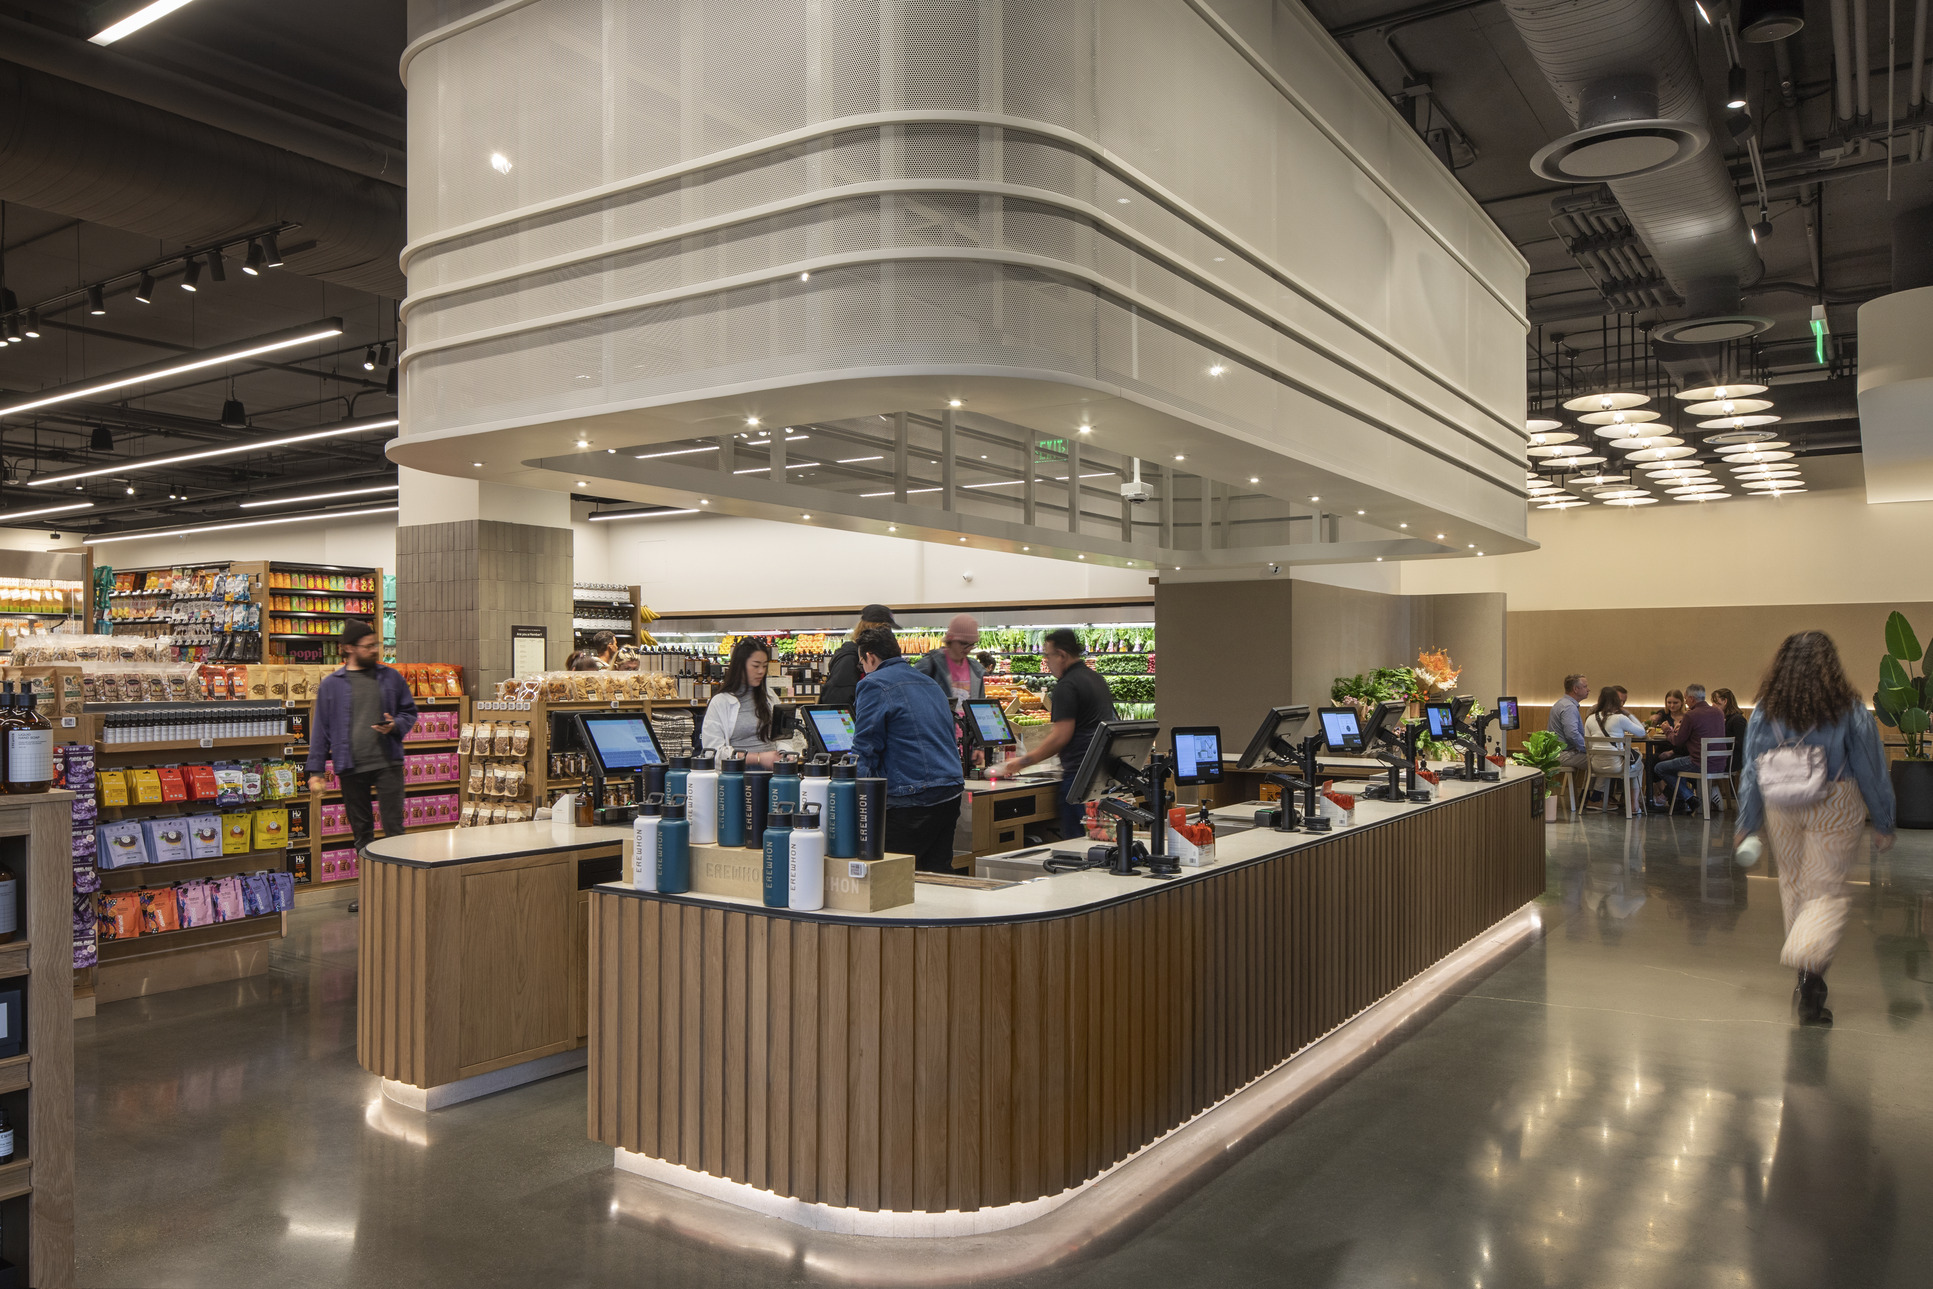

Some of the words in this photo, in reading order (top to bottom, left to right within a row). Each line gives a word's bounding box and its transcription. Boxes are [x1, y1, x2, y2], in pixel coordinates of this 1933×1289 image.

[1040, 440, 1063, 460] EXIT
[771, 788, 779, 814] WHON
[859, 794, 868, 842] EREWHON
[706, 862, 763, 883] EREWHO
[765, 841, 773, 889] EREWHON
